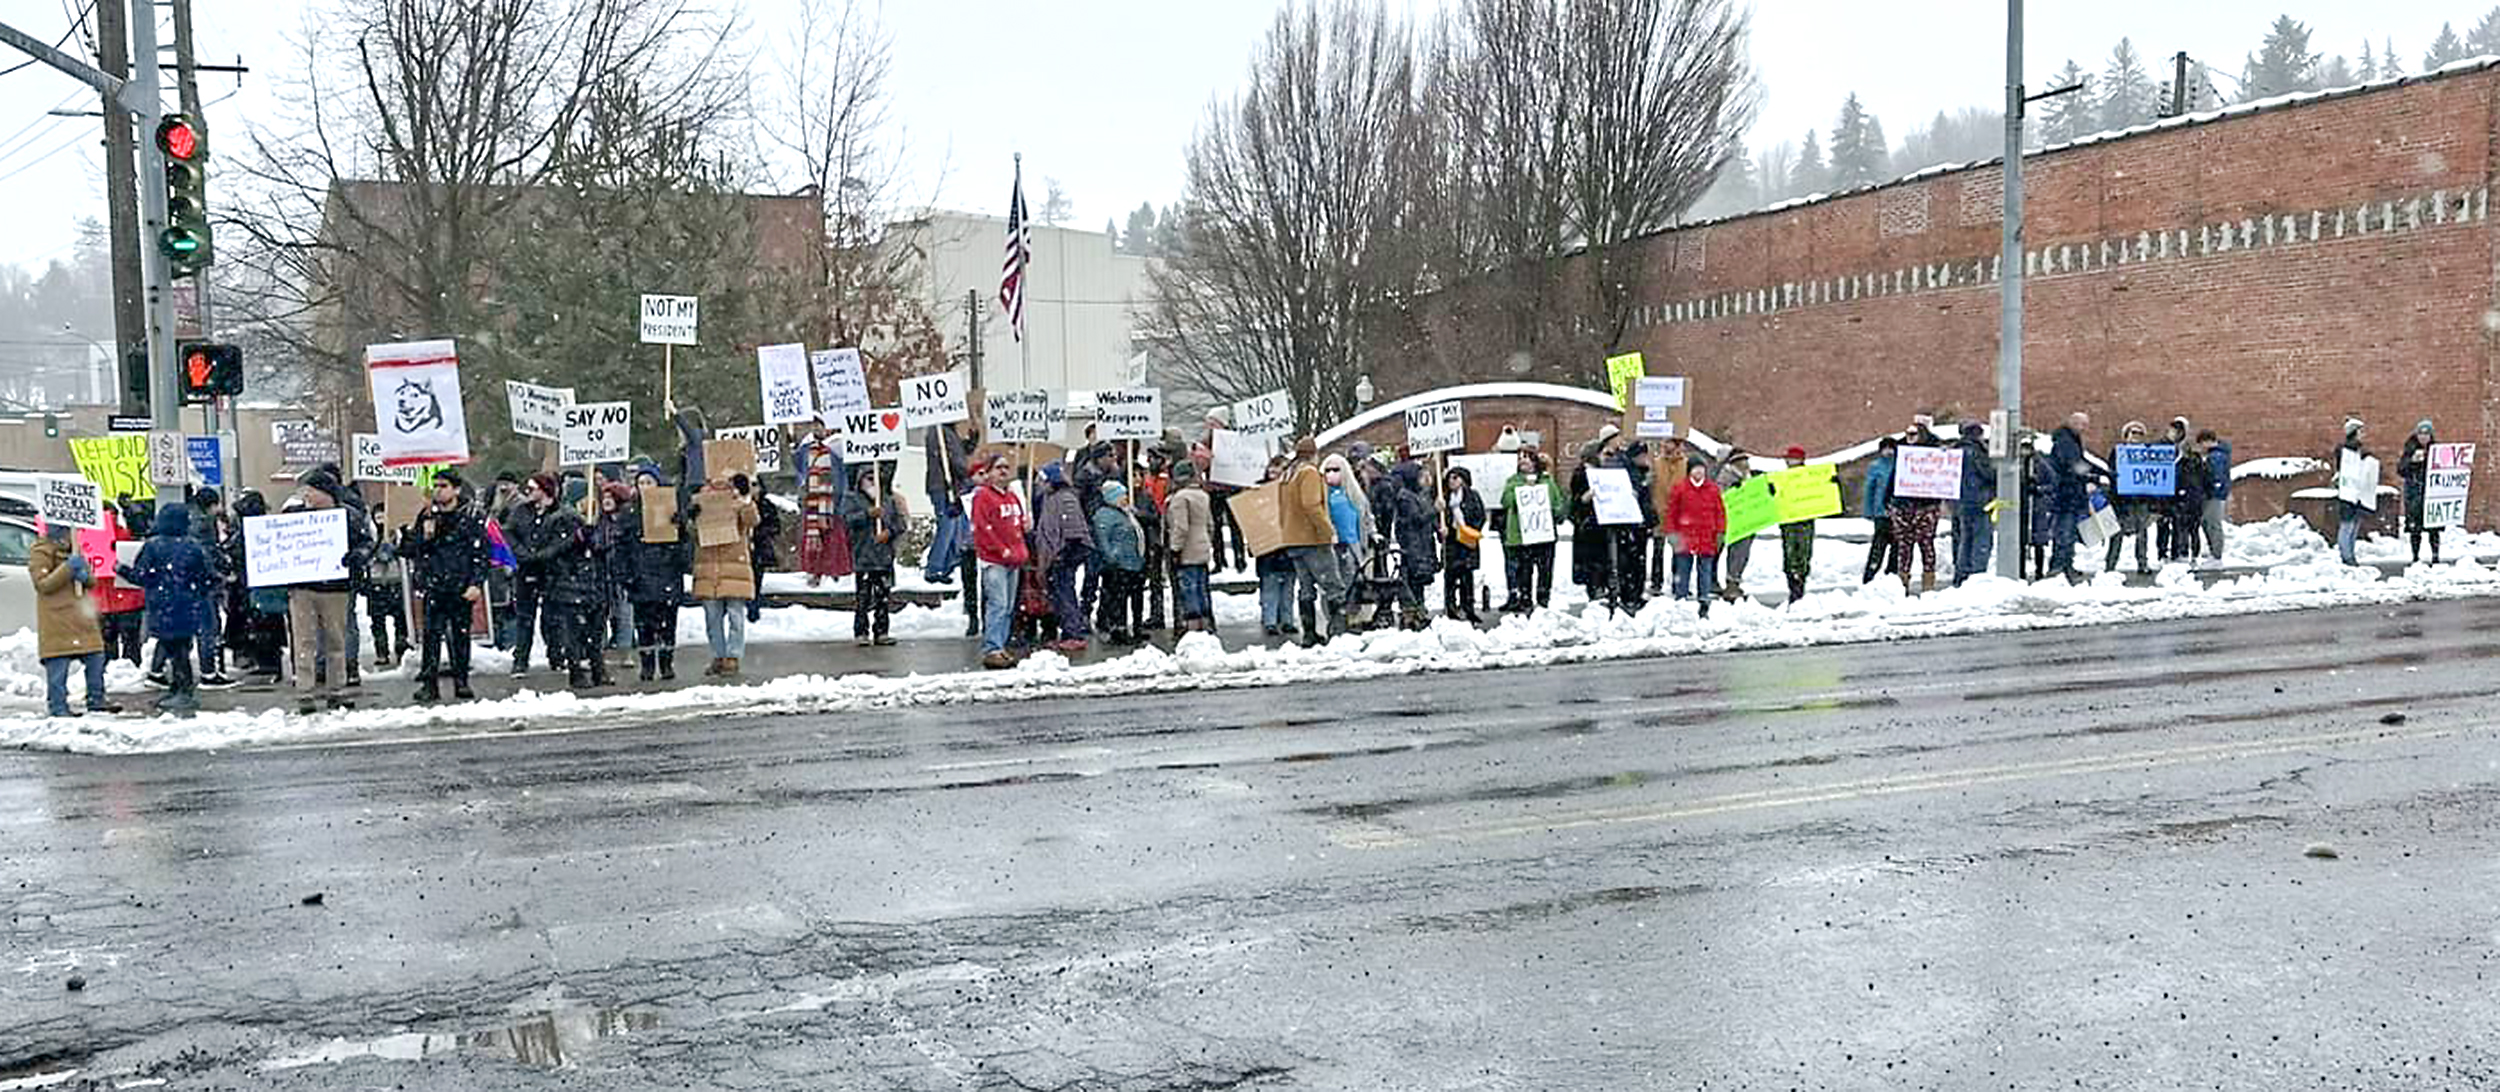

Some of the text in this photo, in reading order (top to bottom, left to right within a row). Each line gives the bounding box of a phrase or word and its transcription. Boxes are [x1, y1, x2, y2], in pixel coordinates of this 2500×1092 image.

[646, 298, 696, 317] NOT MY
[916, 379, 948, 401] NO
[1096, 391, 1153, 405] Welcome
[565, 406, 628, 428] SAY NO
[1247, 398, 1274, 419] NO
[1408, 402, 1459, 428] NOT MY
[845, 413, 878, 434] WE
[74, 435, 147, 460] DEFUND
[753, 428, 779, 447] NO
[846, 440, 900, 458] Refugees
[2432, 445, 2473, 470] LOVE
[84, 460, 156, 499] MUSK
[2132, 468, 2167, 487] DAY!
[44, 493, 91, 512] FEDERAL
[2427, 500, 2462, 524] HATE
